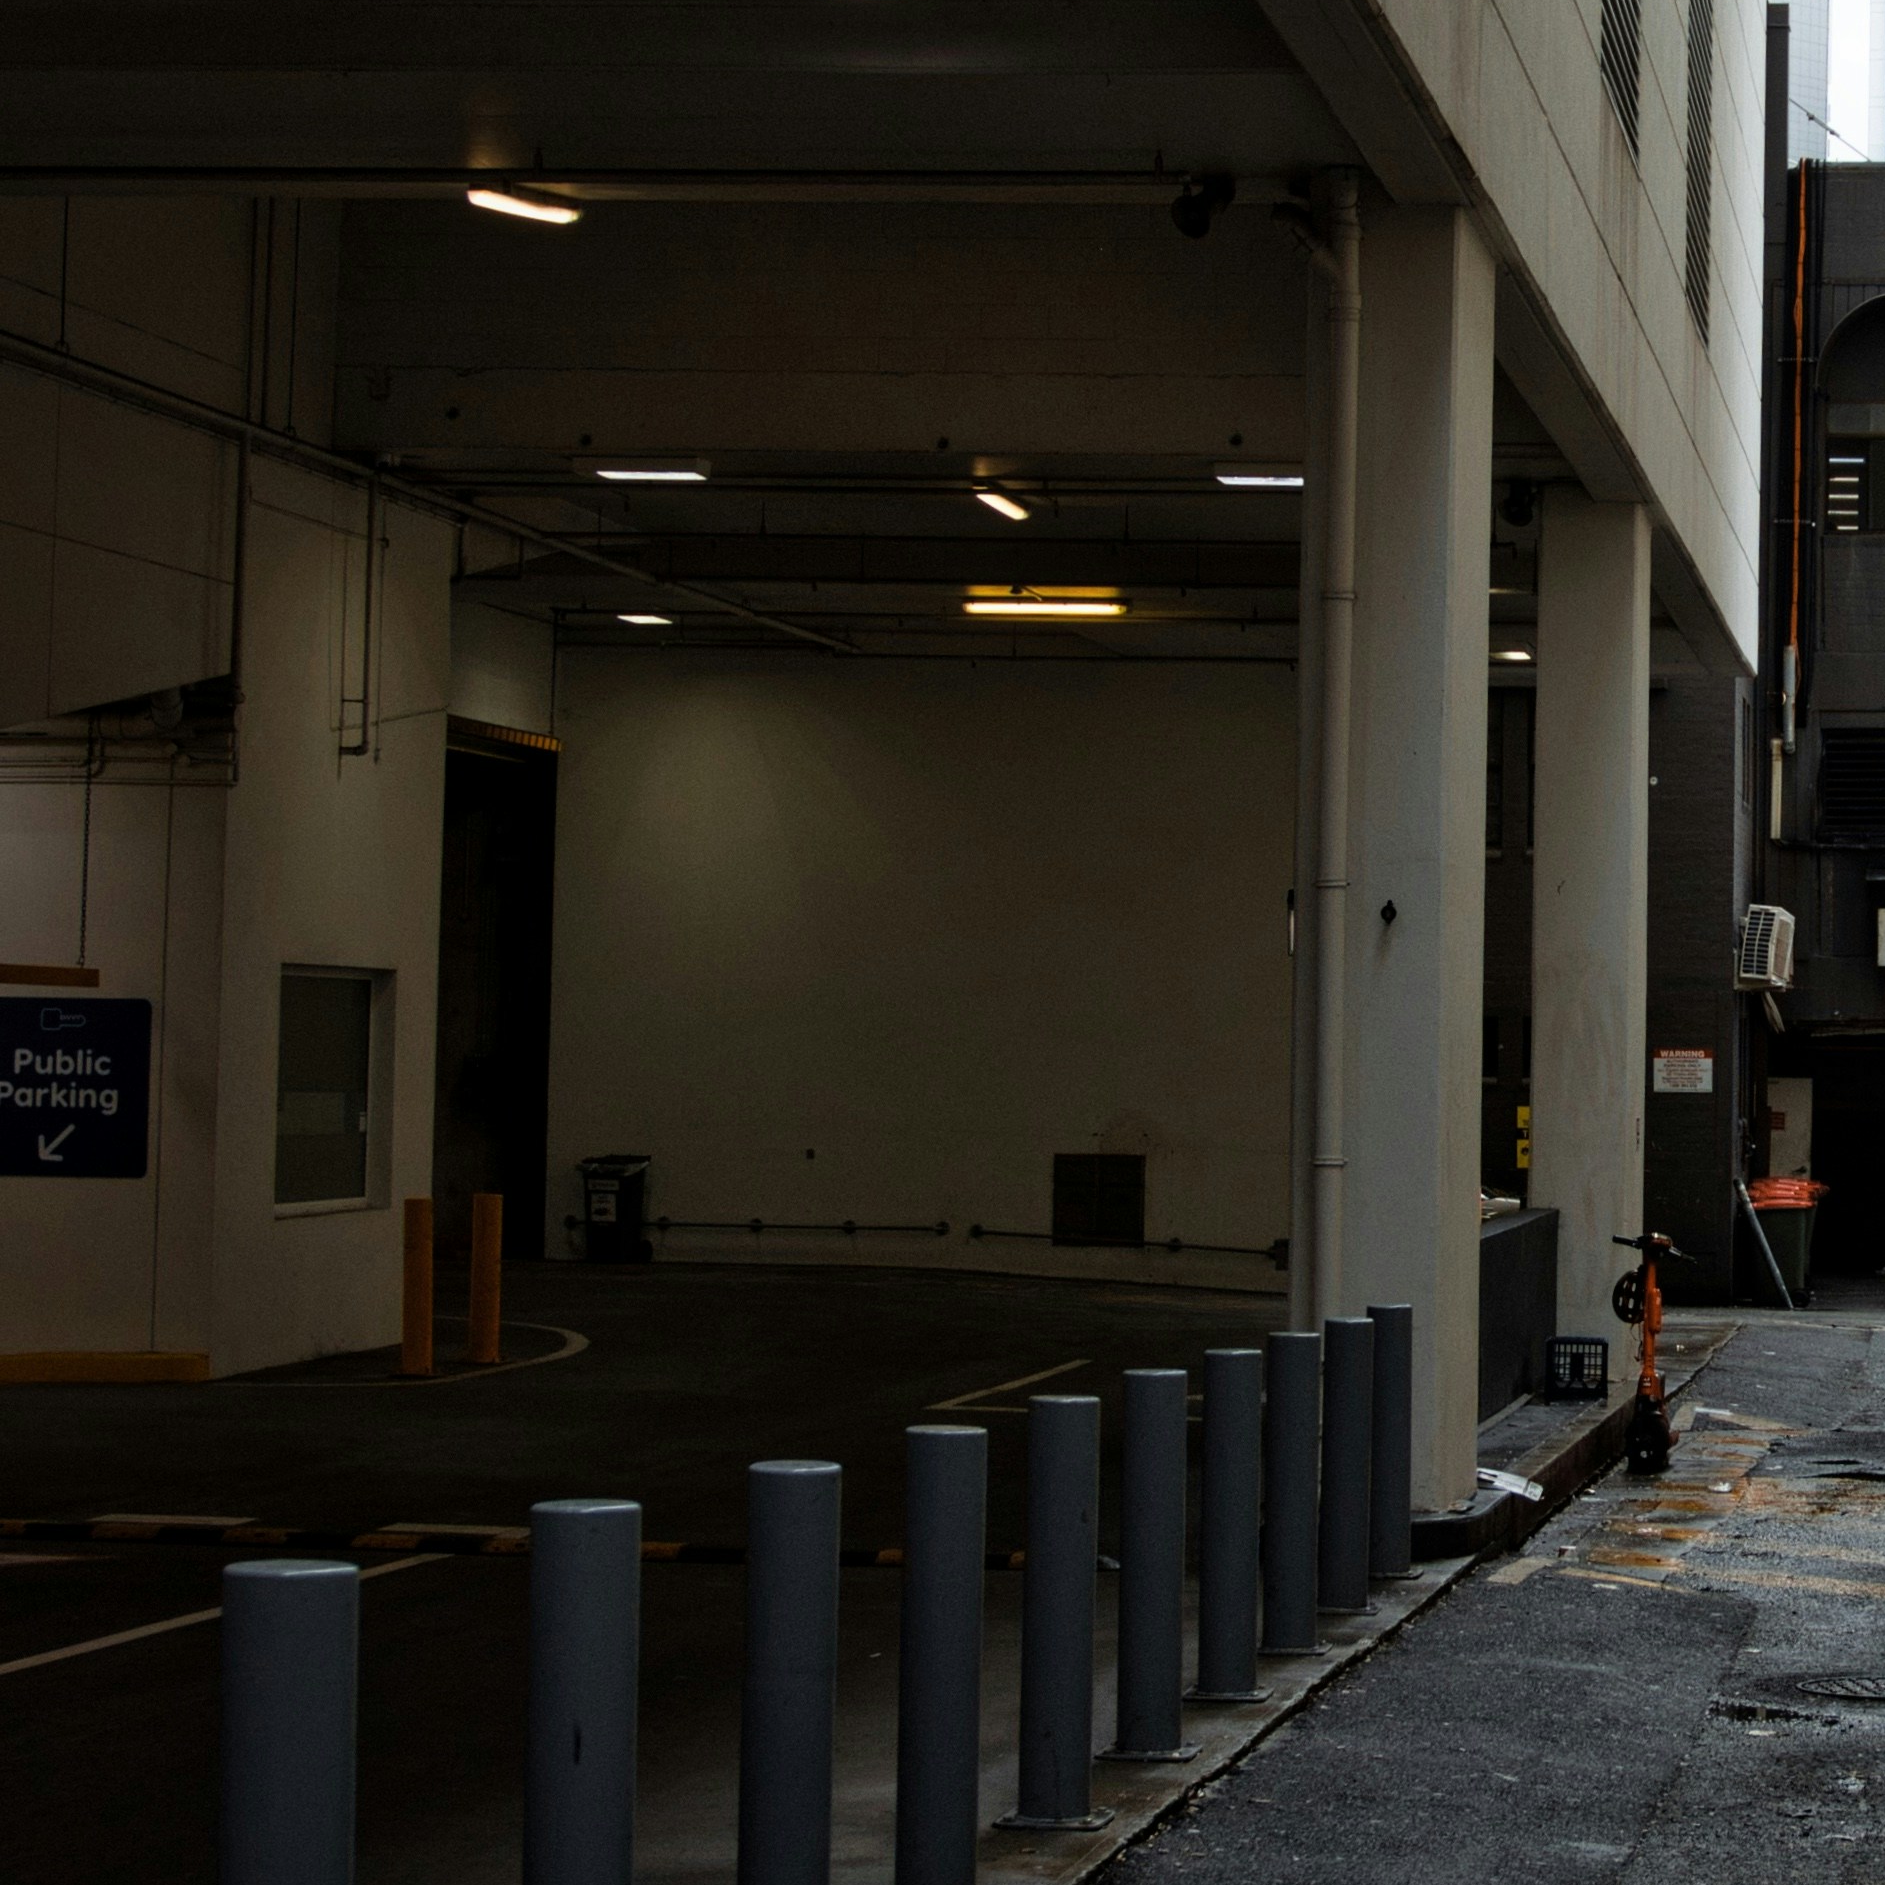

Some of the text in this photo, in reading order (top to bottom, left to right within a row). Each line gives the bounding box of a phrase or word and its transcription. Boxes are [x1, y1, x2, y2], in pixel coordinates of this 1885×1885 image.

[14, 1048, 112, 1076] Public
[1660, 1049, 1705, 1058] WARNING
[0, 1081, 119, 1115] Parking
